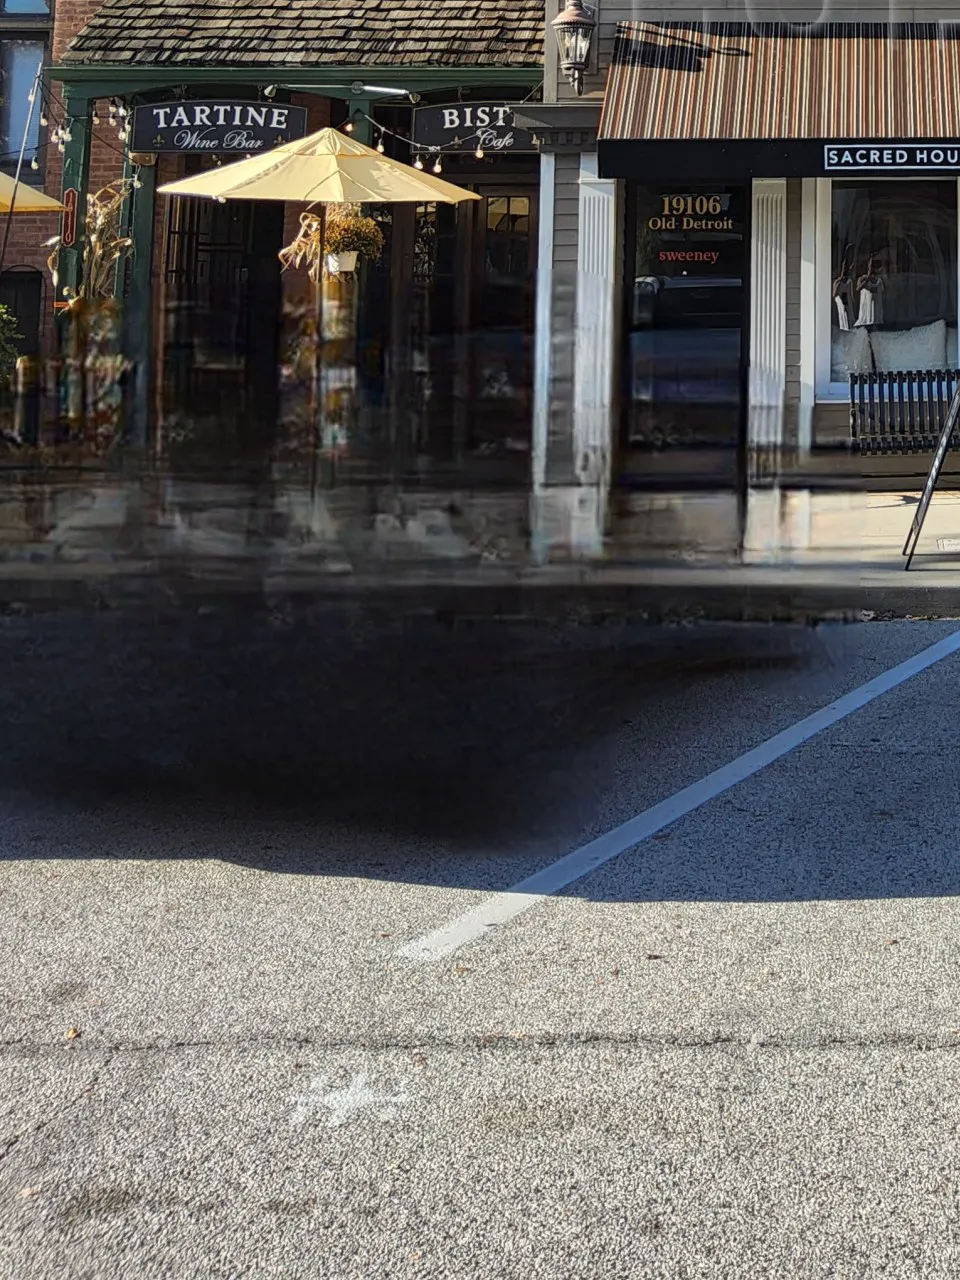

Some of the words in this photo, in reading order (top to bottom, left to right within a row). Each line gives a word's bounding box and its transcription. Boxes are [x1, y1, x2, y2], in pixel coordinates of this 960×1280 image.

[153, 105, 288, 129] TARTINE
[442, 106, 516, 129] BIST
[173, 127, 219, 150] Wine
[222, 129, 265, 150] Bar
[828, 149, 908, 164] SACRED
[661, 195, 721, 215] 19106
[648, 217, 676, 230] Old
[682, 216, 733, 230] Detroit
[659, 250, 719, 265] sweeney
